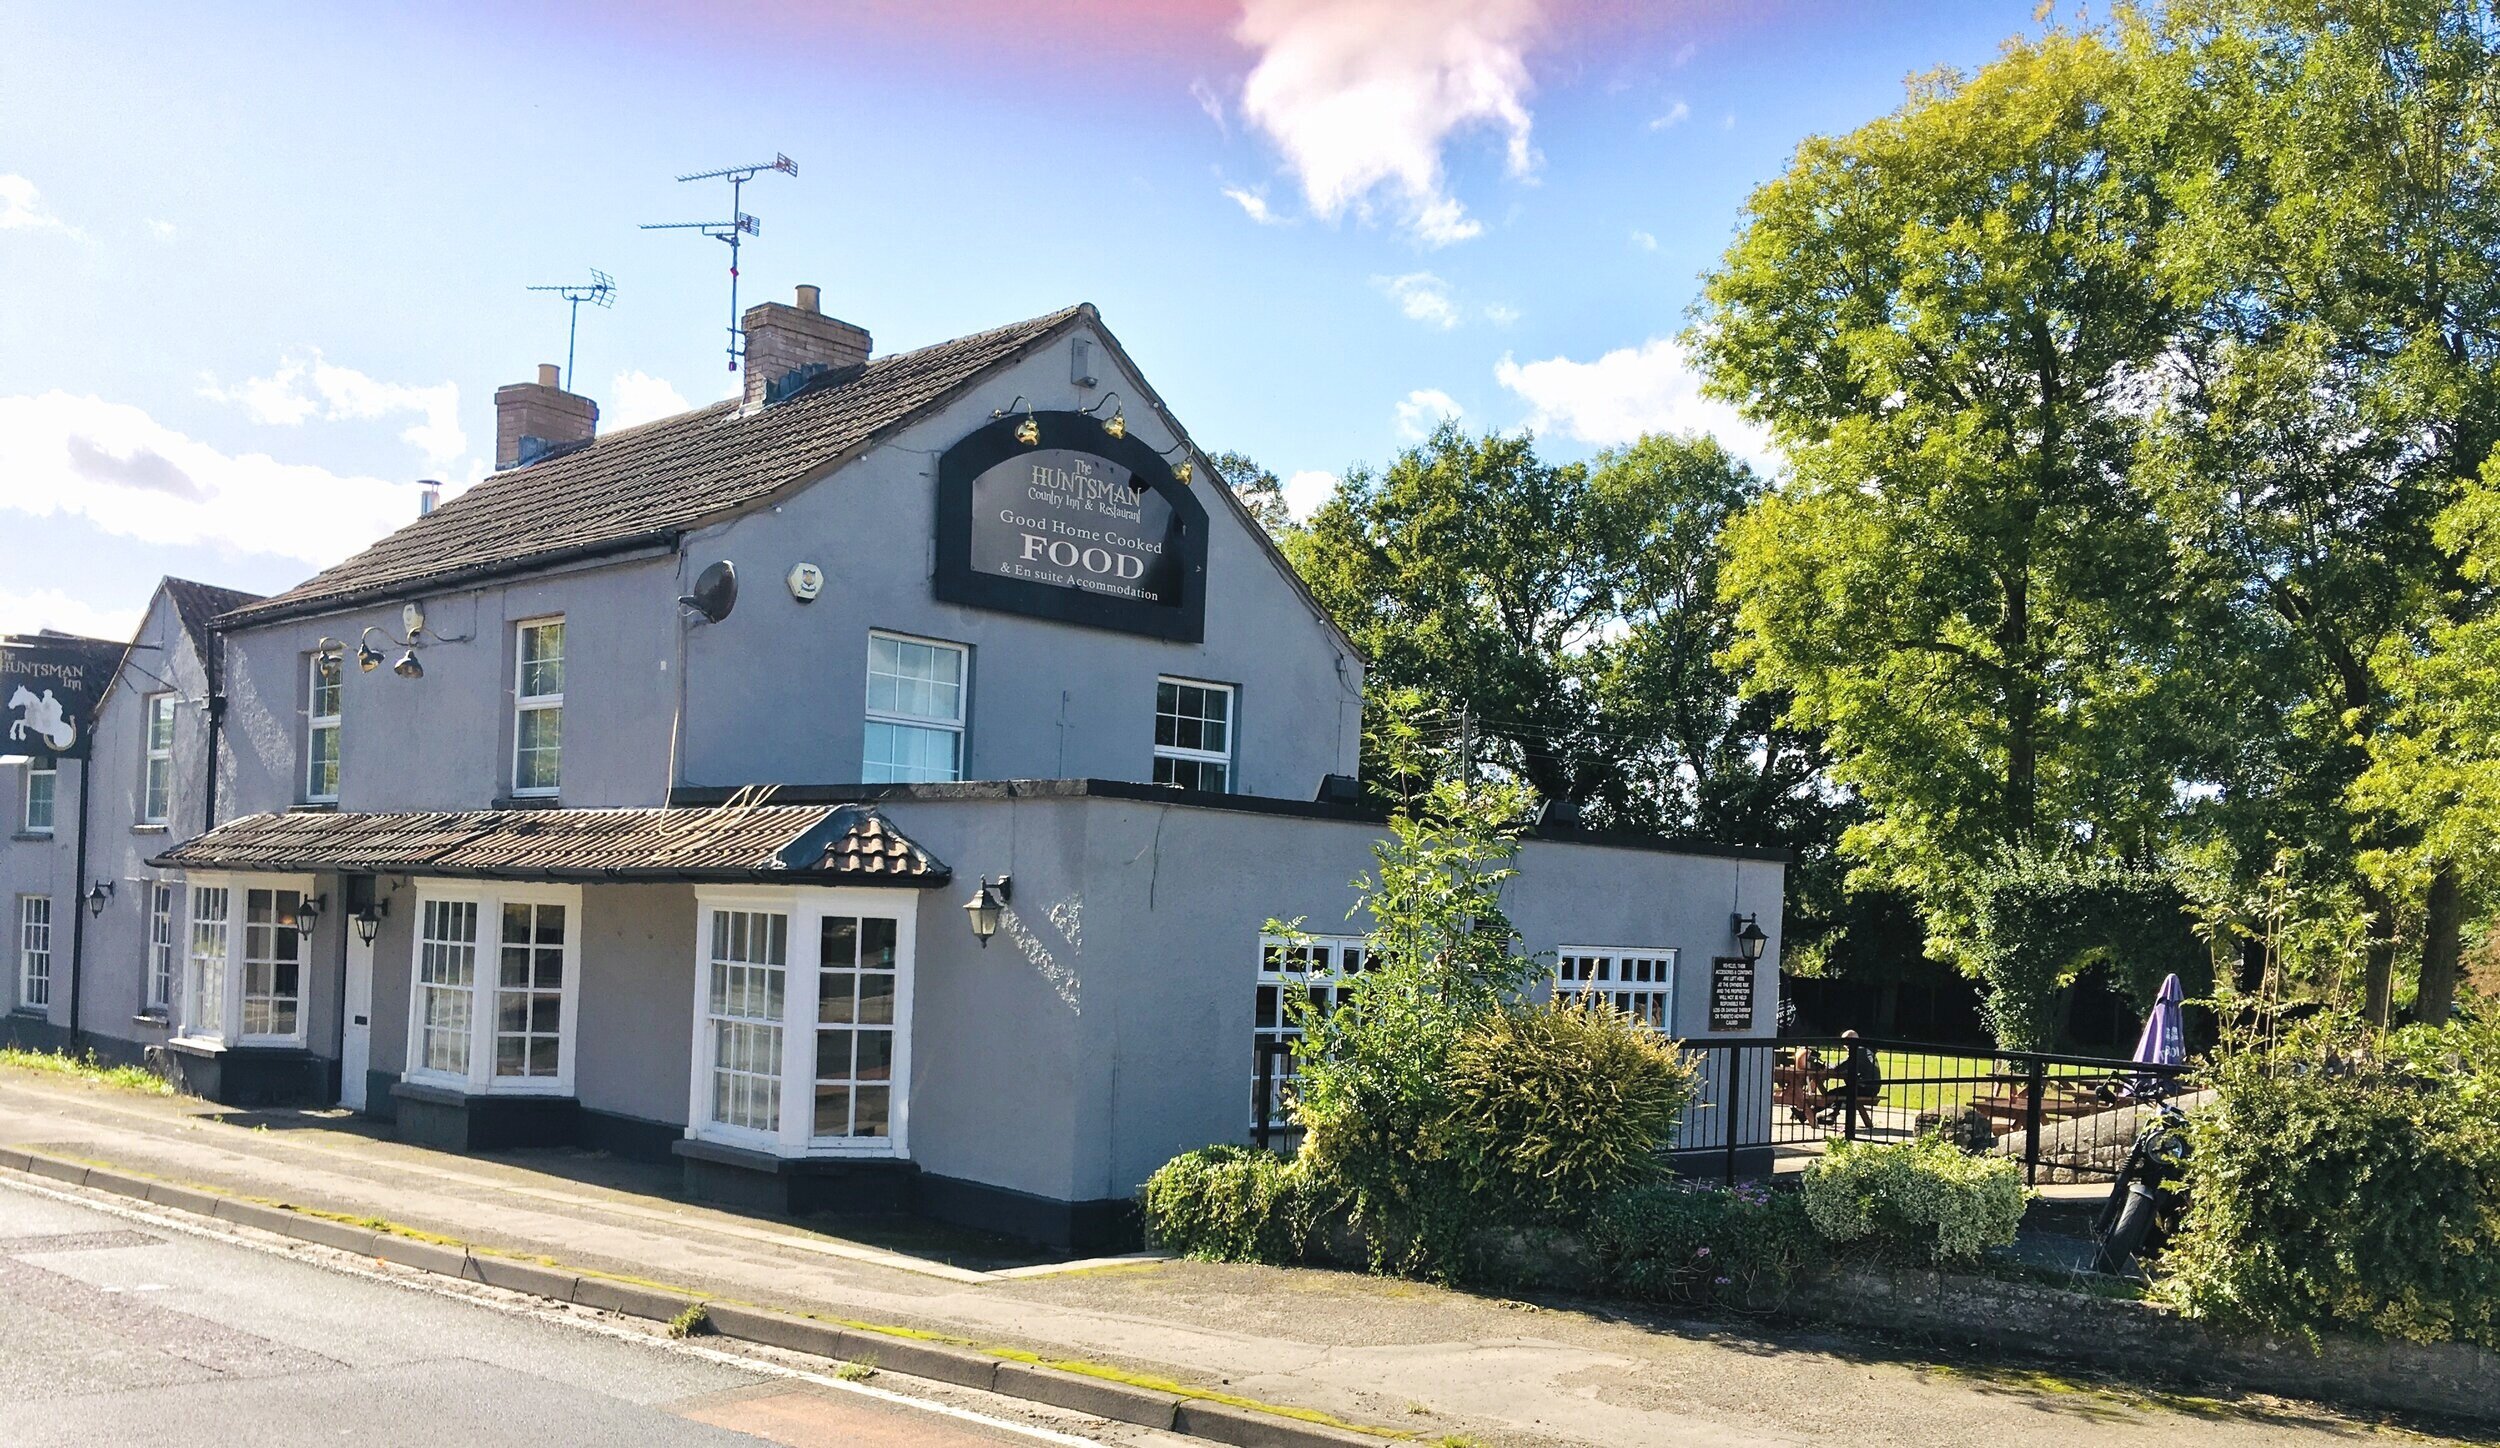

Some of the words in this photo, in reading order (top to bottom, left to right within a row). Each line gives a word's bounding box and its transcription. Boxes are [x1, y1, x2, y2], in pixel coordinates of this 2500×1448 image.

[1031, 465, 1142, 507] HUNTSMAN
[1075, 459, 1092, 475] The
[1028, 487, 1063, 509] Country
[1066, 495, 1080, 510] Inn
[1084, 500, 1093, 511] &
[1099, 502, 1141, 524] Restaurant
[1000, 510, 1046, 530] Good
[1052, 520, 1100, 541] Home
[1105, 532, 1162, 554] Cooked
[1019, 533, 1145, 579] FOOD
[1000, 562, 1011, 574] &
[1015, 564, 1031, 577] En
[1035, 569, 1063, 583] suite
[1066, 575, 1158, 601] Accommodation
[0, 661, 83, 678] HUNTSMAN
[63, 677, 82, 691] Inn
